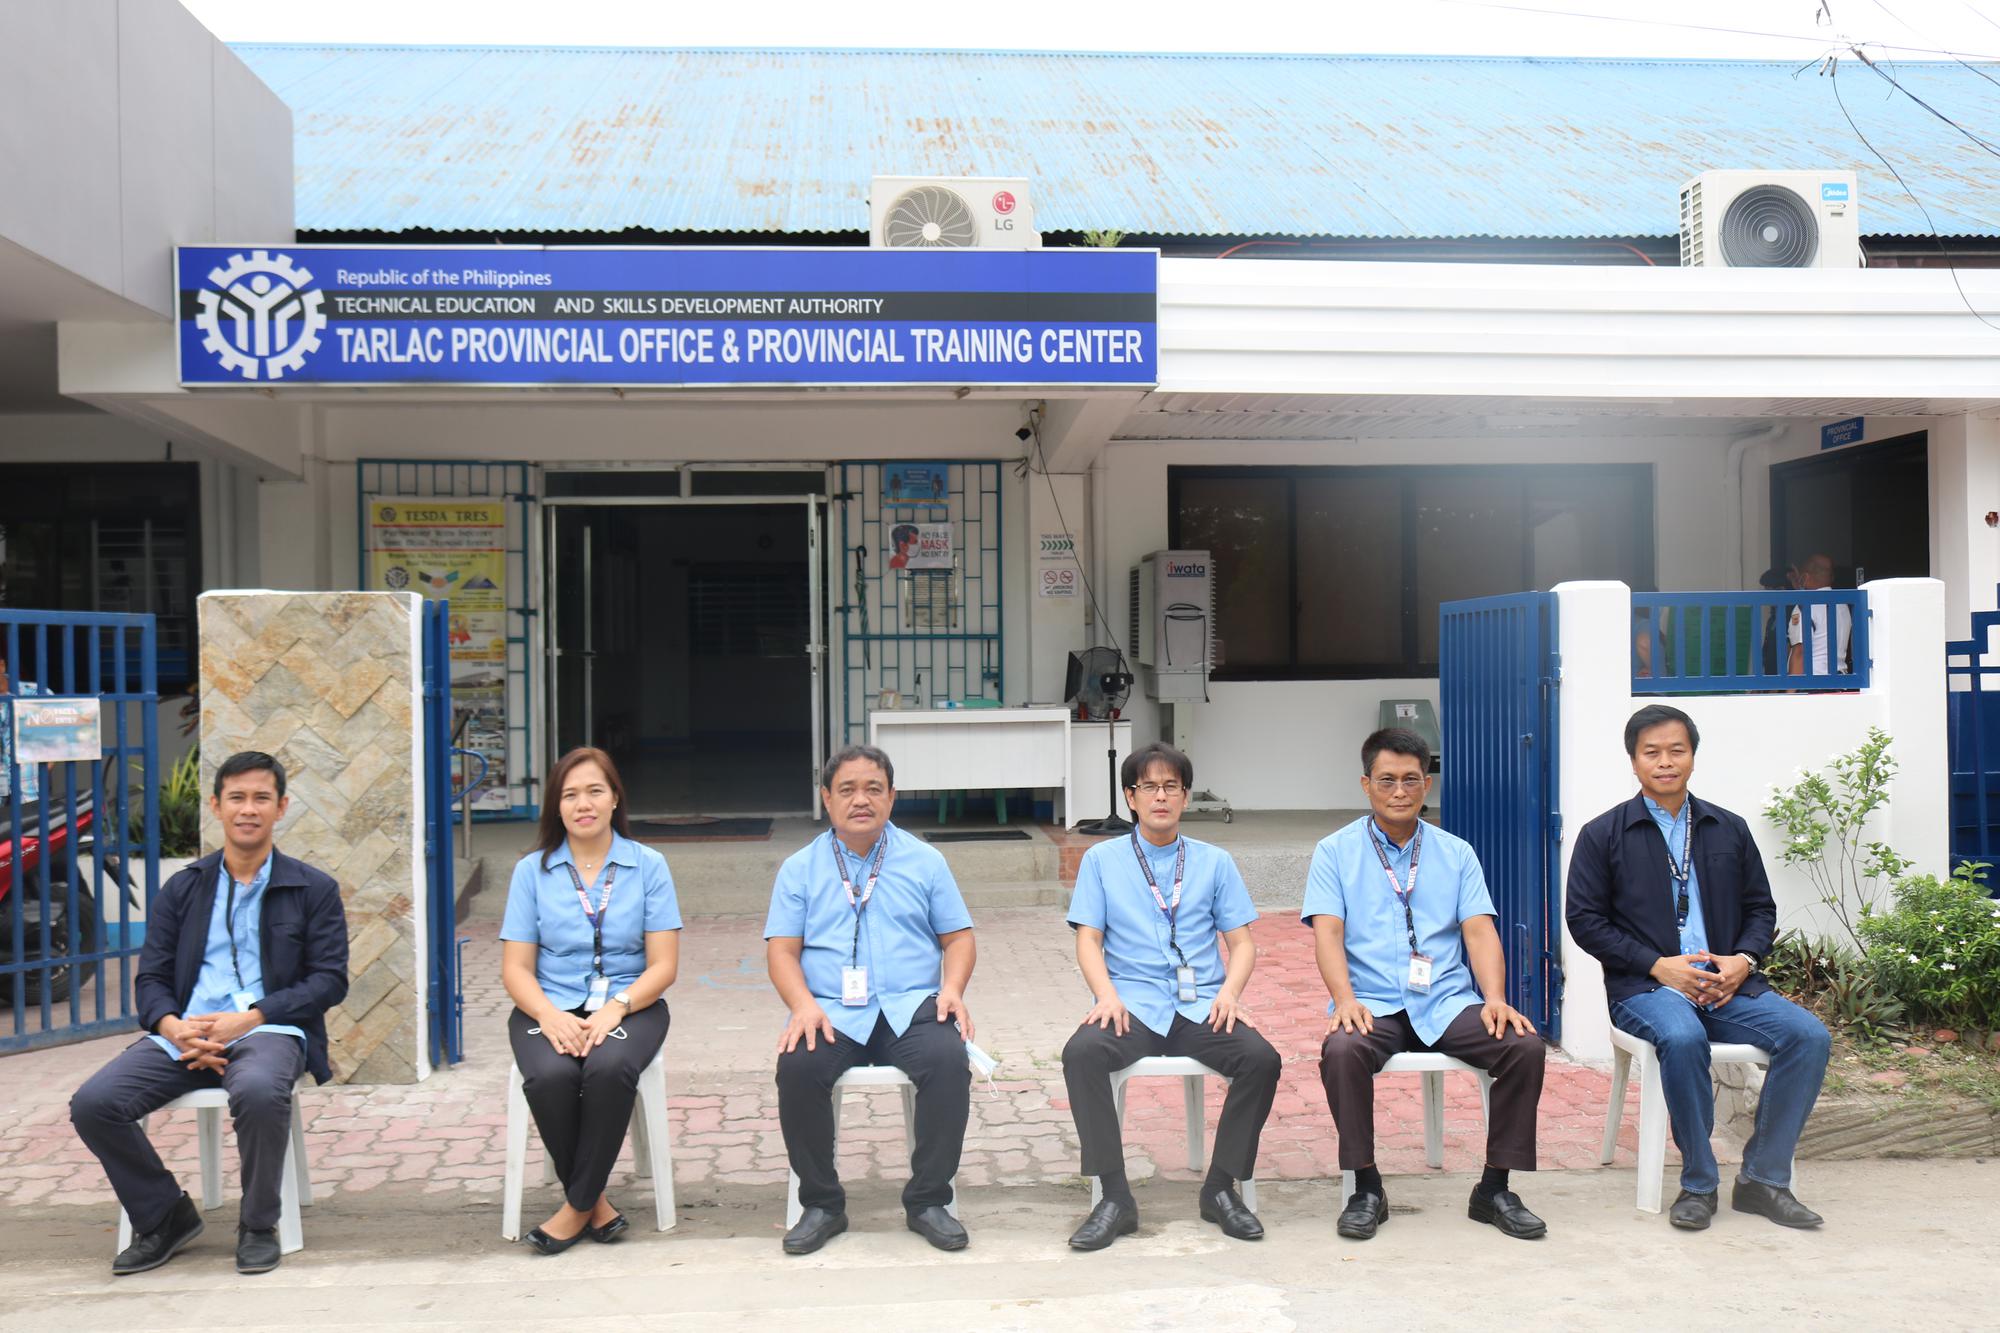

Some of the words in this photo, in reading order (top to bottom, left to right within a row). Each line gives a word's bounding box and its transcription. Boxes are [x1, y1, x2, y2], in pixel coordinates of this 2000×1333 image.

[995, 218, 1014, 231] LG
[337, 269, 408, 288] Republic
[411, 269, 429, 285] of
[432, 270, 460, 285] the
[463, 269, 552, 289] Philippines
[335, 297, 433, 314] TECHNICAL
[436, 297, 536, 314] EDUCATION
[553, 297, 595, 314] AND
[603, 297, 657, 314] SKILLS
[661, 298, 786, 314] DEVELOPMENT
[788, 298, 884, 314] AUTHORITY
[336, 327, 444, 363] TARLAC
[451, 327, 613, 363] PROVINCIAL
[619, 327, 715, 364] OFFICE
[721, 328, 741, 364] &
[747, 328, 905, 364] PROVINCIAL
[910, 328, 1033, 364] TRAINING
[1040, 328, 1144, 364] CENTER
[1826, 421, 1857, 436] PROVINCIAL
[1832, 431, 1852, 444] OFFICE
[405, 511, 448, 522] TESDA
[455, 511, 489, 522] TRES
[921, 539, 949, 550] MASK
[1168, 561, 1206, 574] iwata
